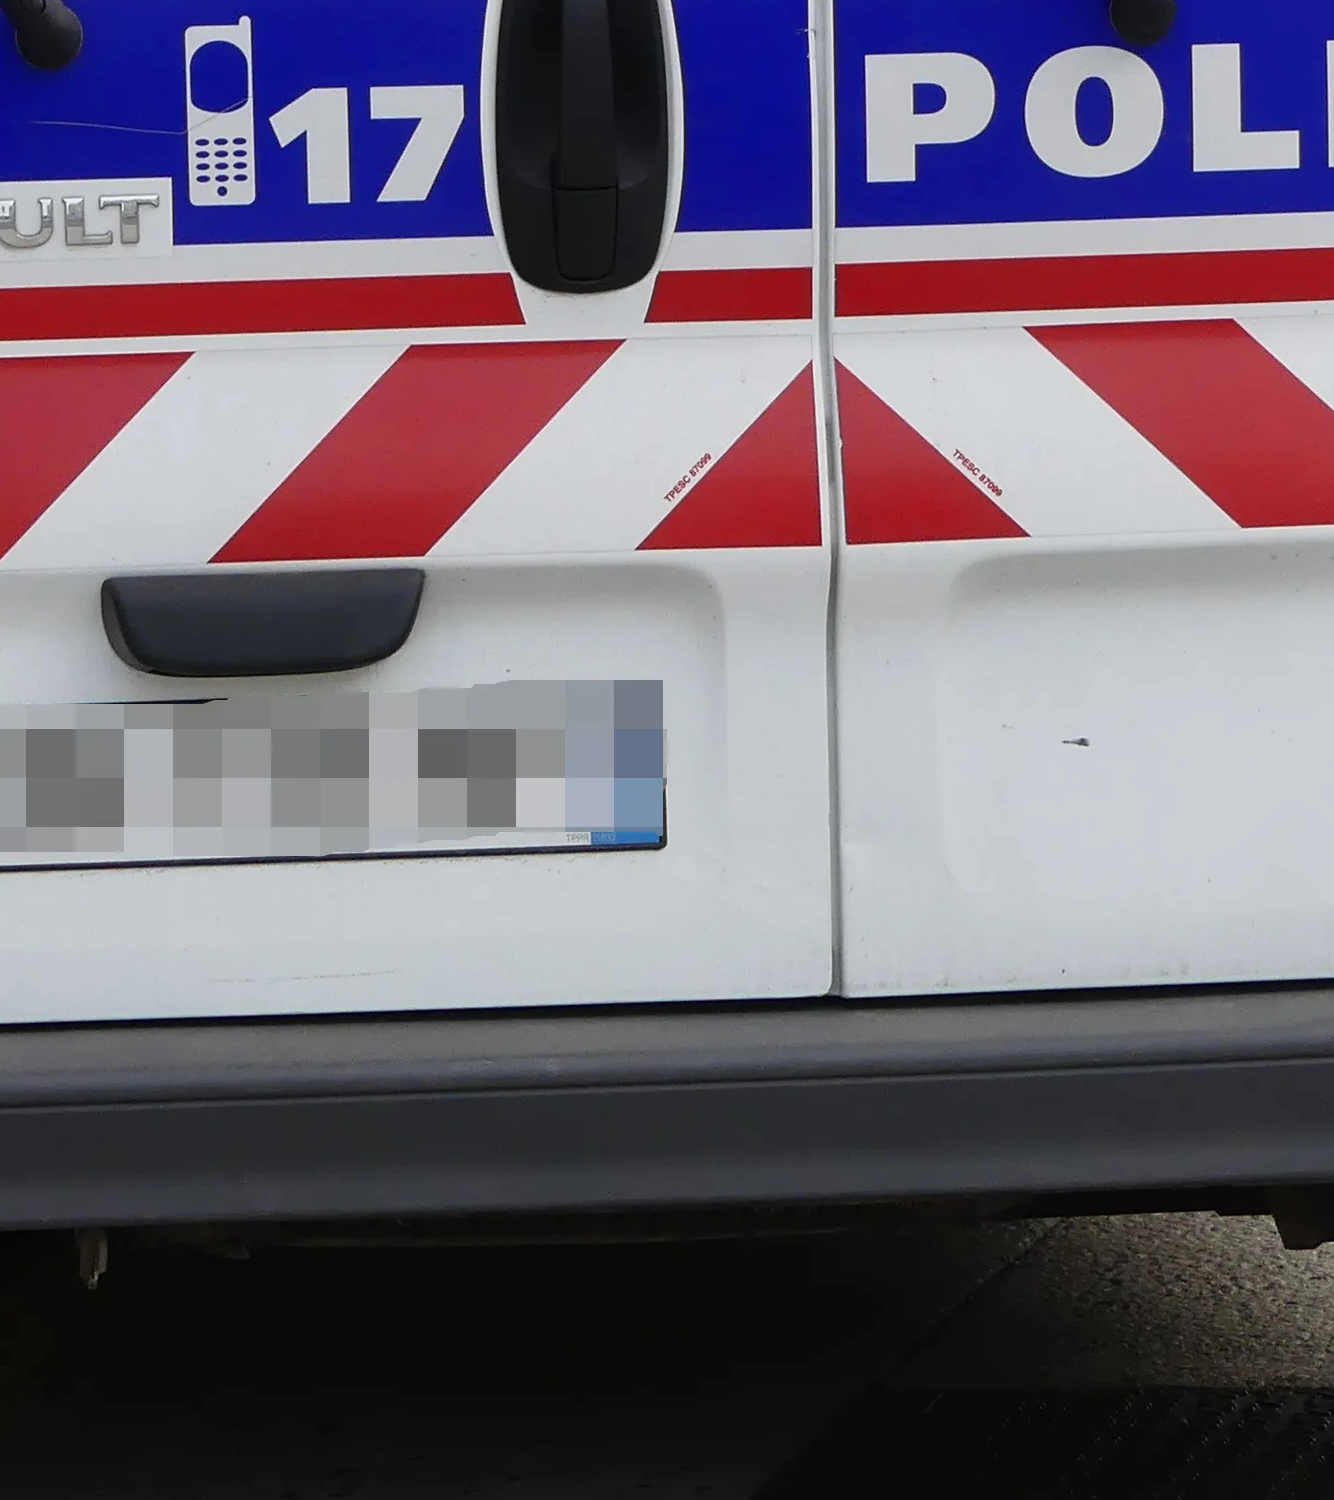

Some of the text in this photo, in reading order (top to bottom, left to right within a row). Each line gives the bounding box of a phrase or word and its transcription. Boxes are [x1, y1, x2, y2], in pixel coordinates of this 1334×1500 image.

[268, 85, 465, 204] 17
[952, 448, 981, 476] TPESC
[663, 475, 691, 502] TPESC
